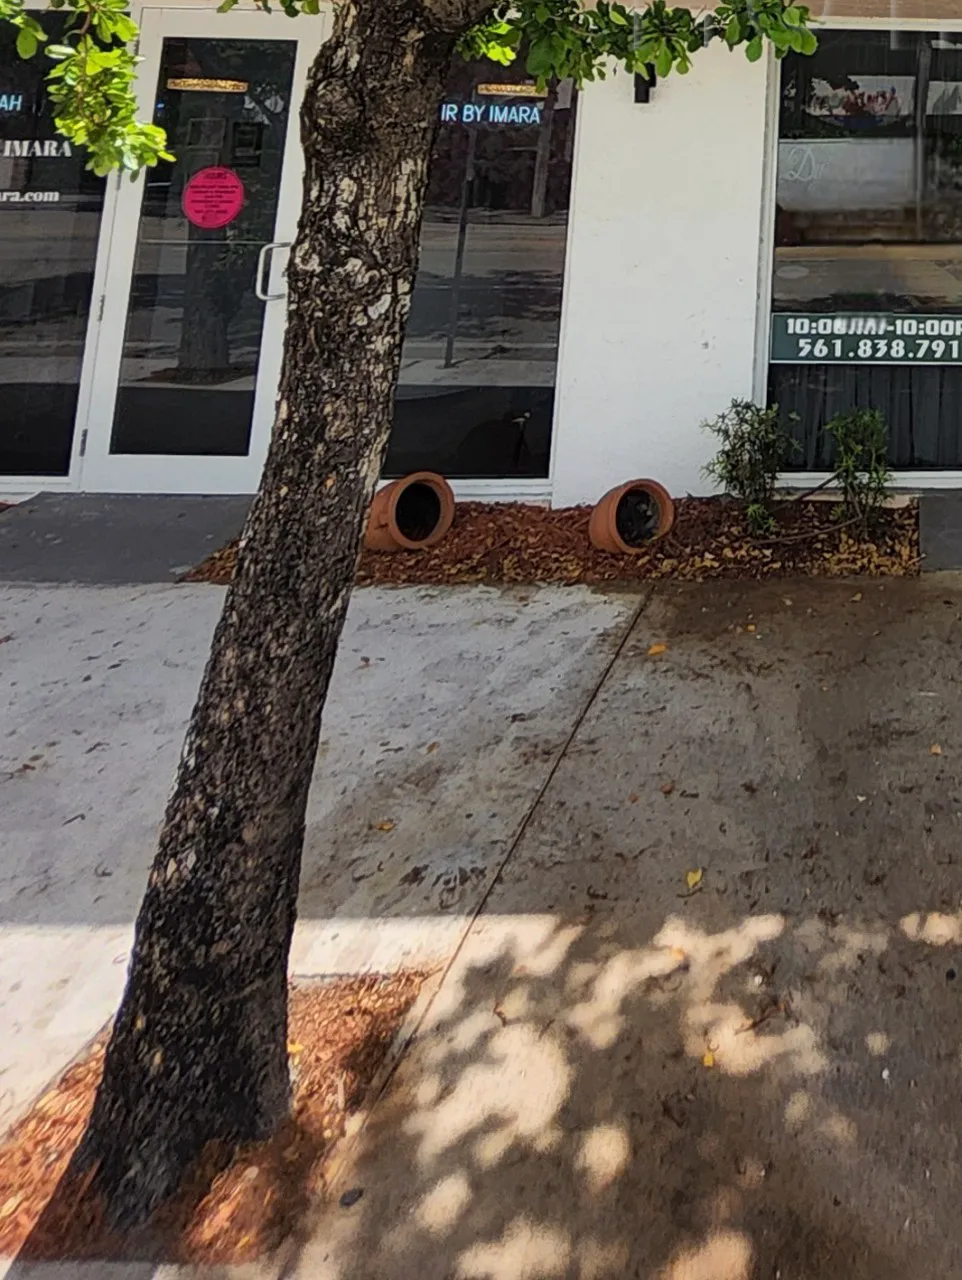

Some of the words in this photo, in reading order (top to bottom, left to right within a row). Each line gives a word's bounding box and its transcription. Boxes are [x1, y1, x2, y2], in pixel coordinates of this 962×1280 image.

[462, 104, 486, 122] BY
[489, 104, 541, 124] IMARA
[3, 139, 72, 157] IMARA
